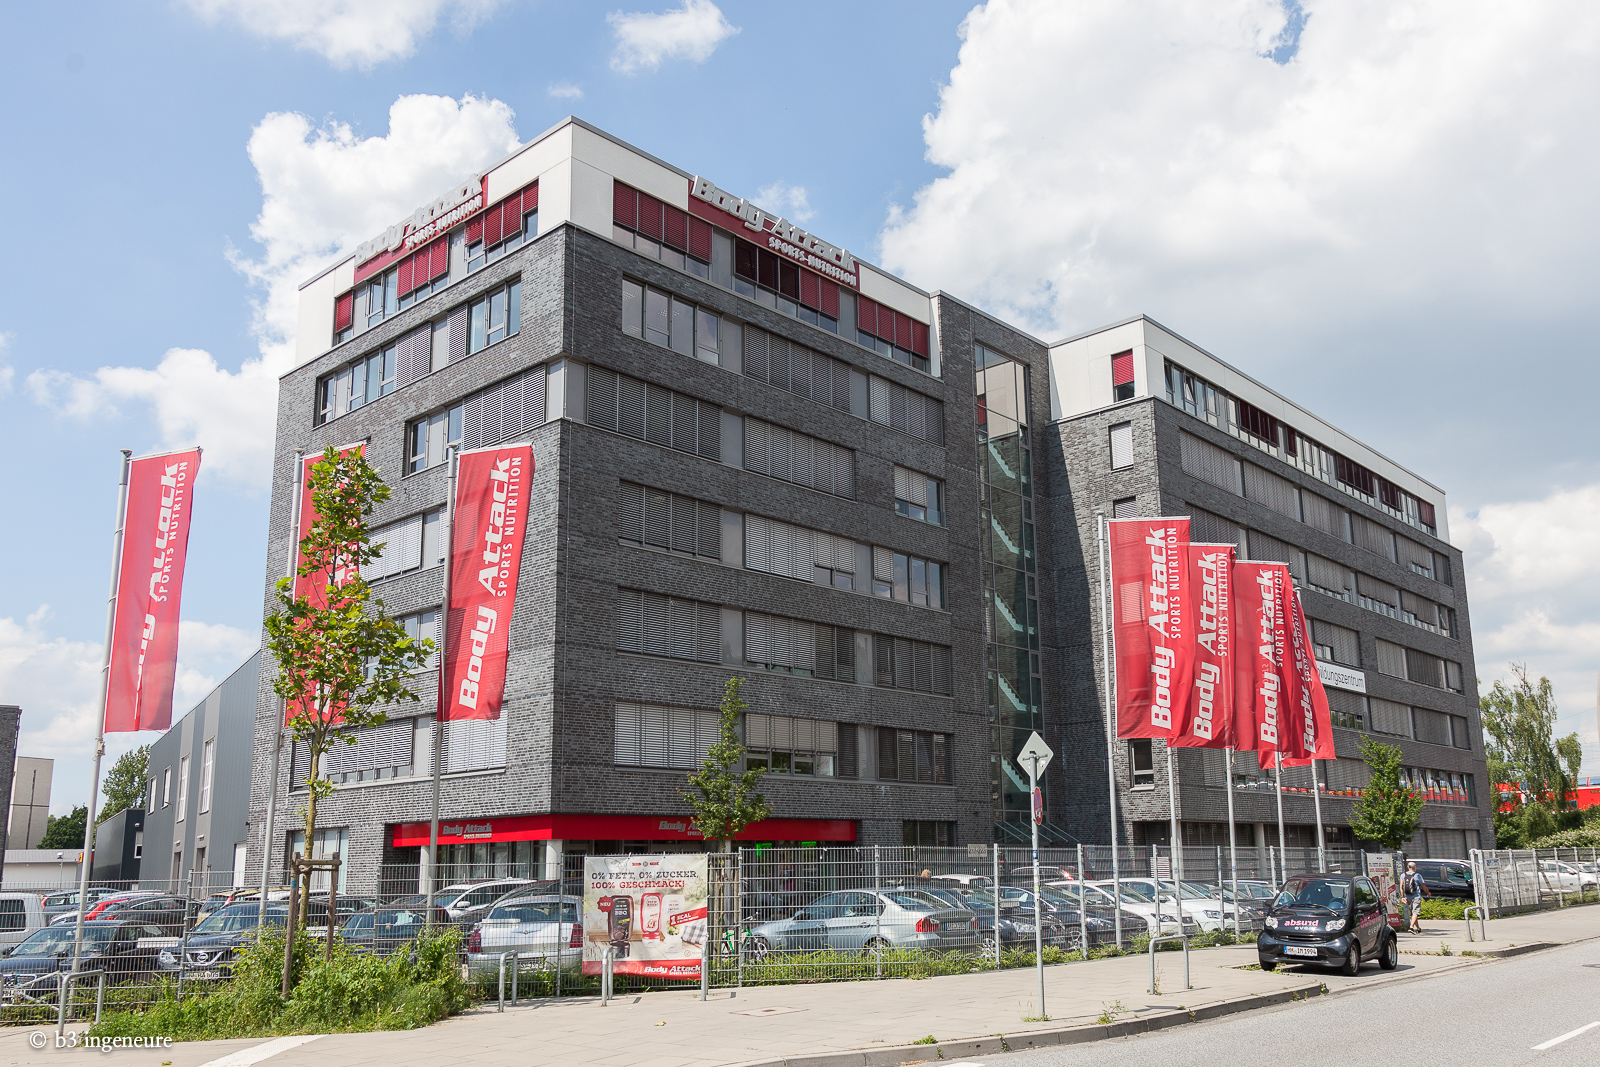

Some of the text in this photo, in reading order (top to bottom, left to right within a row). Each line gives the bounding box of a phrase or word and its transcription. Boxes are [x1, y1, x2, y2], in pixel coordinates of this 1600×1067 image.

[690, 174, 857, 273] Body Attack
[156, 461, 188, 602] SPORTS NUTRITION
[497, 456, 522, 597] SPORTS NUTRITION
[459, 456, 511, 711] Body Attack
[1145, 527, 1176, 730] Body Attack
[1167, 527, 1182, 639] SPORTS NUTRITION
[1217, 552, 1228, 657] SPORTS NUTRITION
[1274, 570, 1285, 667] SPORTS NUTRITION
[1193, 551, 1221, 741] Body Attack
[1256, 568, 1281, 745] Body Attack
[442, 823, 492, 837] Body Attack
[591, 870, 699, 880] 0% FETT, 0% ZUCKER,
[659, 820, 686, 833] Body
[619, 880, 685, 889] GESCHMACK!
[670, 915, 677, 926] 1
[644, 964, 701, 974] Body Attack
